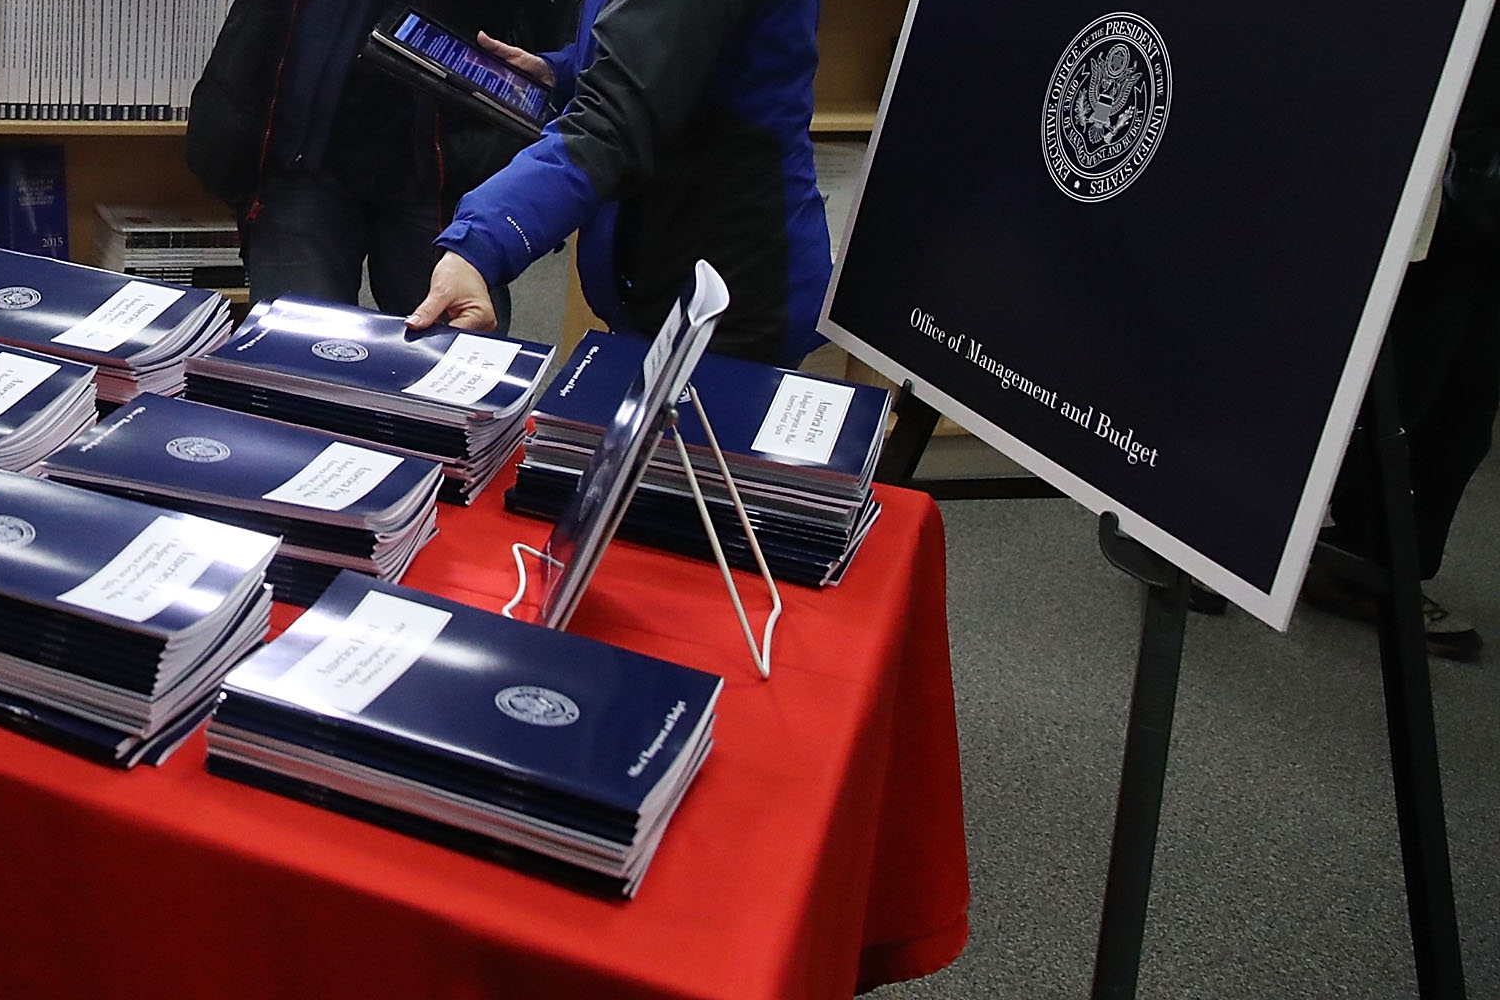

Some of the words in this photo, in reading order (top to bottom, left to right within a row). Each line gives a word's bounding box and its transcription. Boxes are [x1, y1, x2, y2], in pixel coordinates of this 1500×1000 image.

[1105, 21, 1161, 60] PRESIDENT
[1051, 45, 1081, 100] OFFICE
[1046, 102, 1071, 181] EXECUTIVE
[1133, 105, 1165, 166] UNITED
[1089, 162, 1133, 194] STATES
[42, 236, 64, 248] 2015
[910, 307, 946, 343] Office
[948, 333, 966, 354] of
[965, 338, 1059, 410] Management
[1060, 405, 1094, 430] and
[1093, 412, 1160, 467] Budget
[811, 400, 833, 427] America
[805, 428, 823, 443] First
